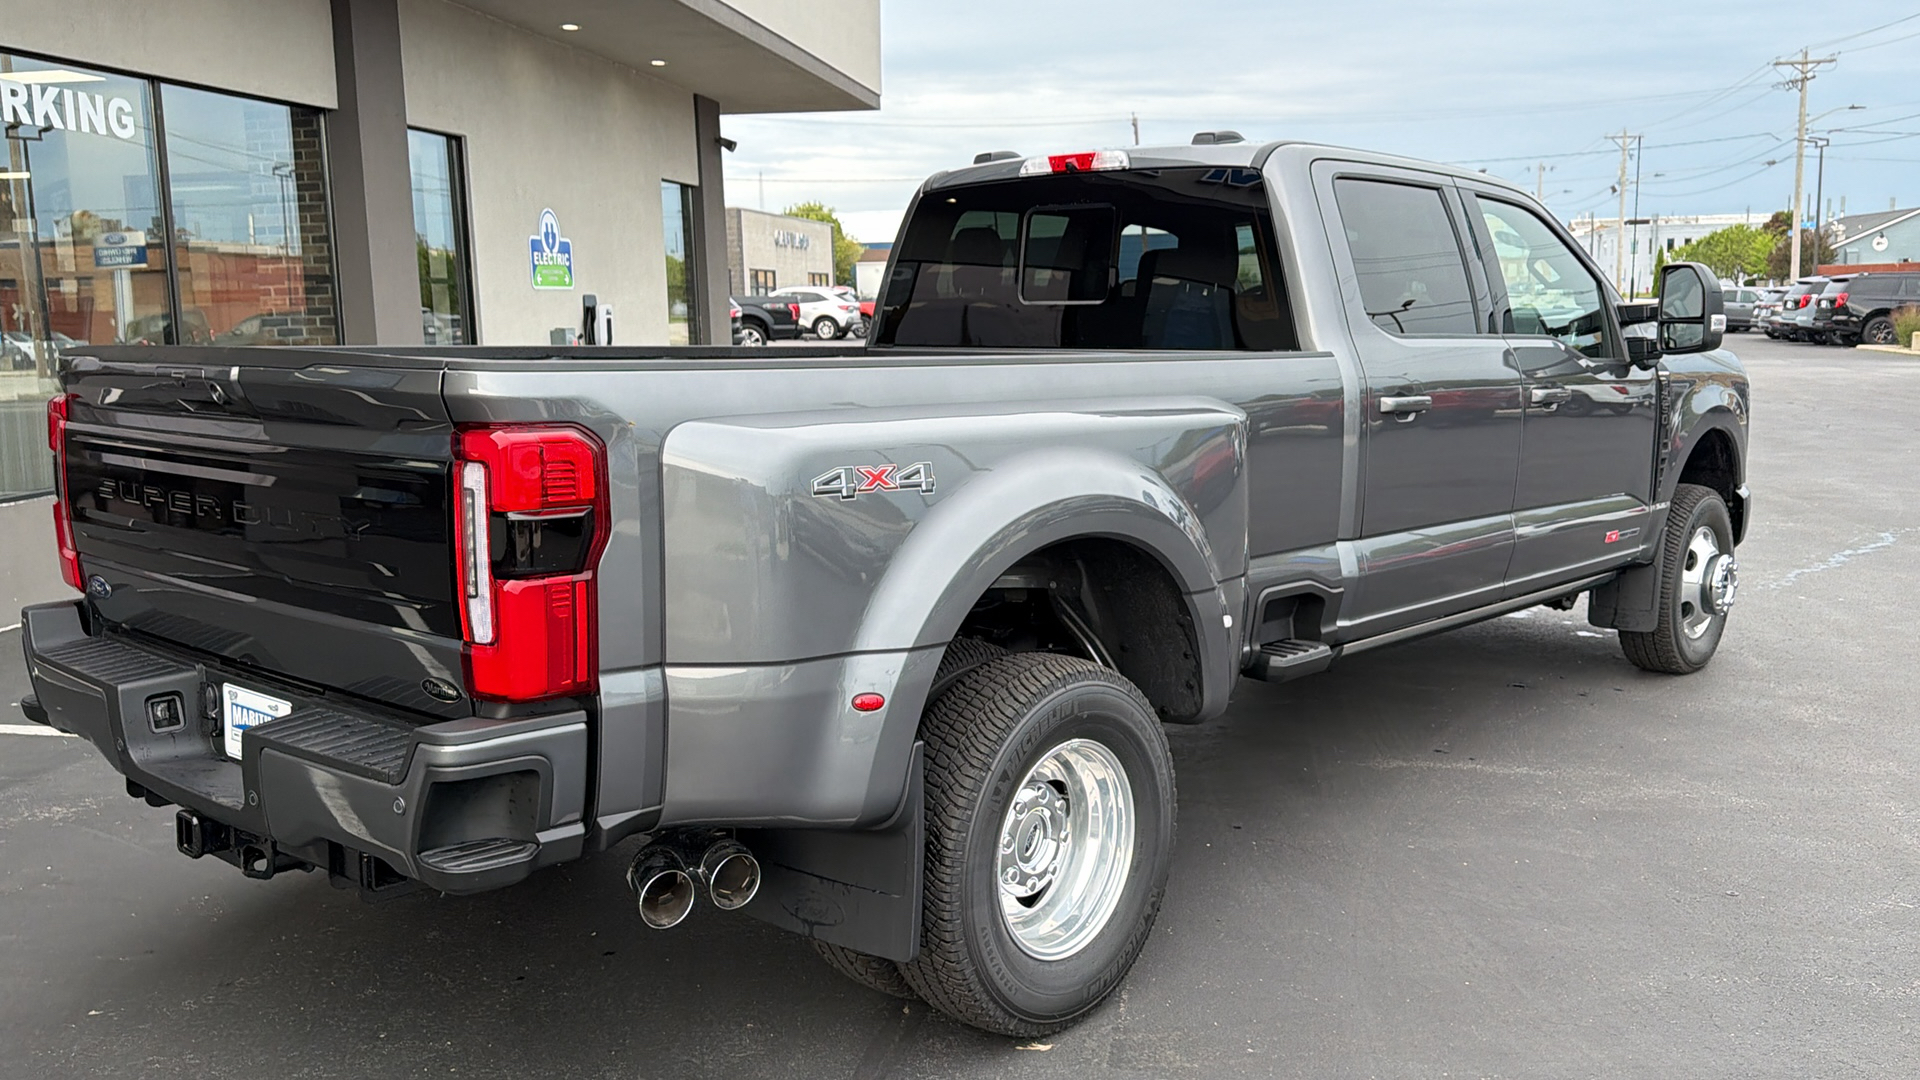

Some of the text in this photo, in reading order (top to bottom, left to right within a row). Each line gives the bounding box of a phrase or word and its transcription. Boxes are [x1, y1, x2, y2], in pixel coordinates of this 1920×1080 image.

[0, 80, 135, 139] RKING
[533, 251, 570, 267] ELECTRIC
[811, 461, 936, 501] 4X4
[98, 477, 371, 542] SUPER DUTY
[232, 703, 275, 727] MARITI
[1004, 700, 1073, 777] MICHELIN
